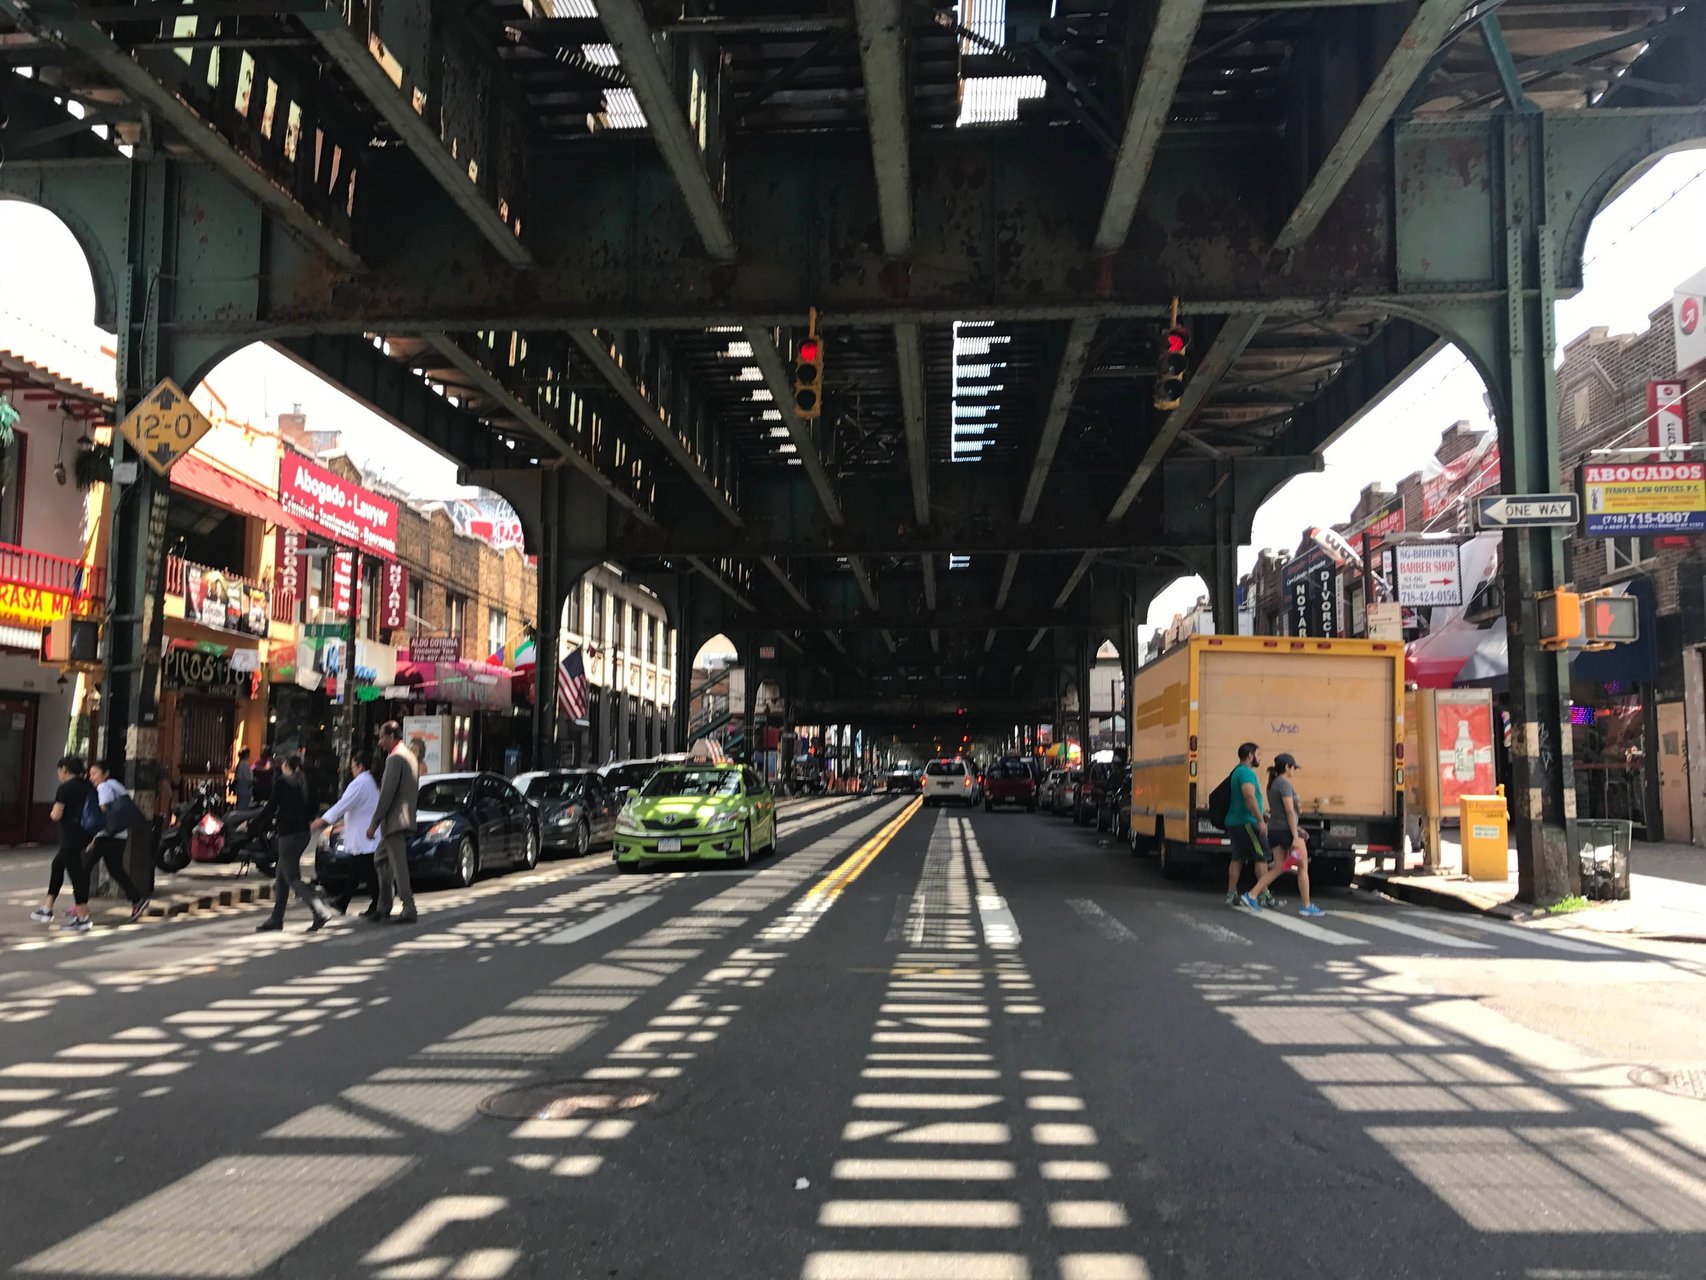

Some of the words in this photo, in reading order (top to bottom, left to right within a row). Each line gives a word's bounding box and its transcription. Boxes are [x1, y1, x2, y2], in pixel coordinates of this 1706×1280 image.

[1587, 465, 1702, 482] ABOGADOS
[294, 465, 346, 508] Abogado
[354, 493, 388, 528] Lawyer
[1505, 504, 1532, 516] ONE
[1539, 504, 1567, 515] WAY
[1628, 512, 1691, 525] 715-0907
[1400, 561, 1432, 574] BARBER
[1434, 560, 1456, 573] SHOP
[388, 564, 401, 627] NOTARIO
